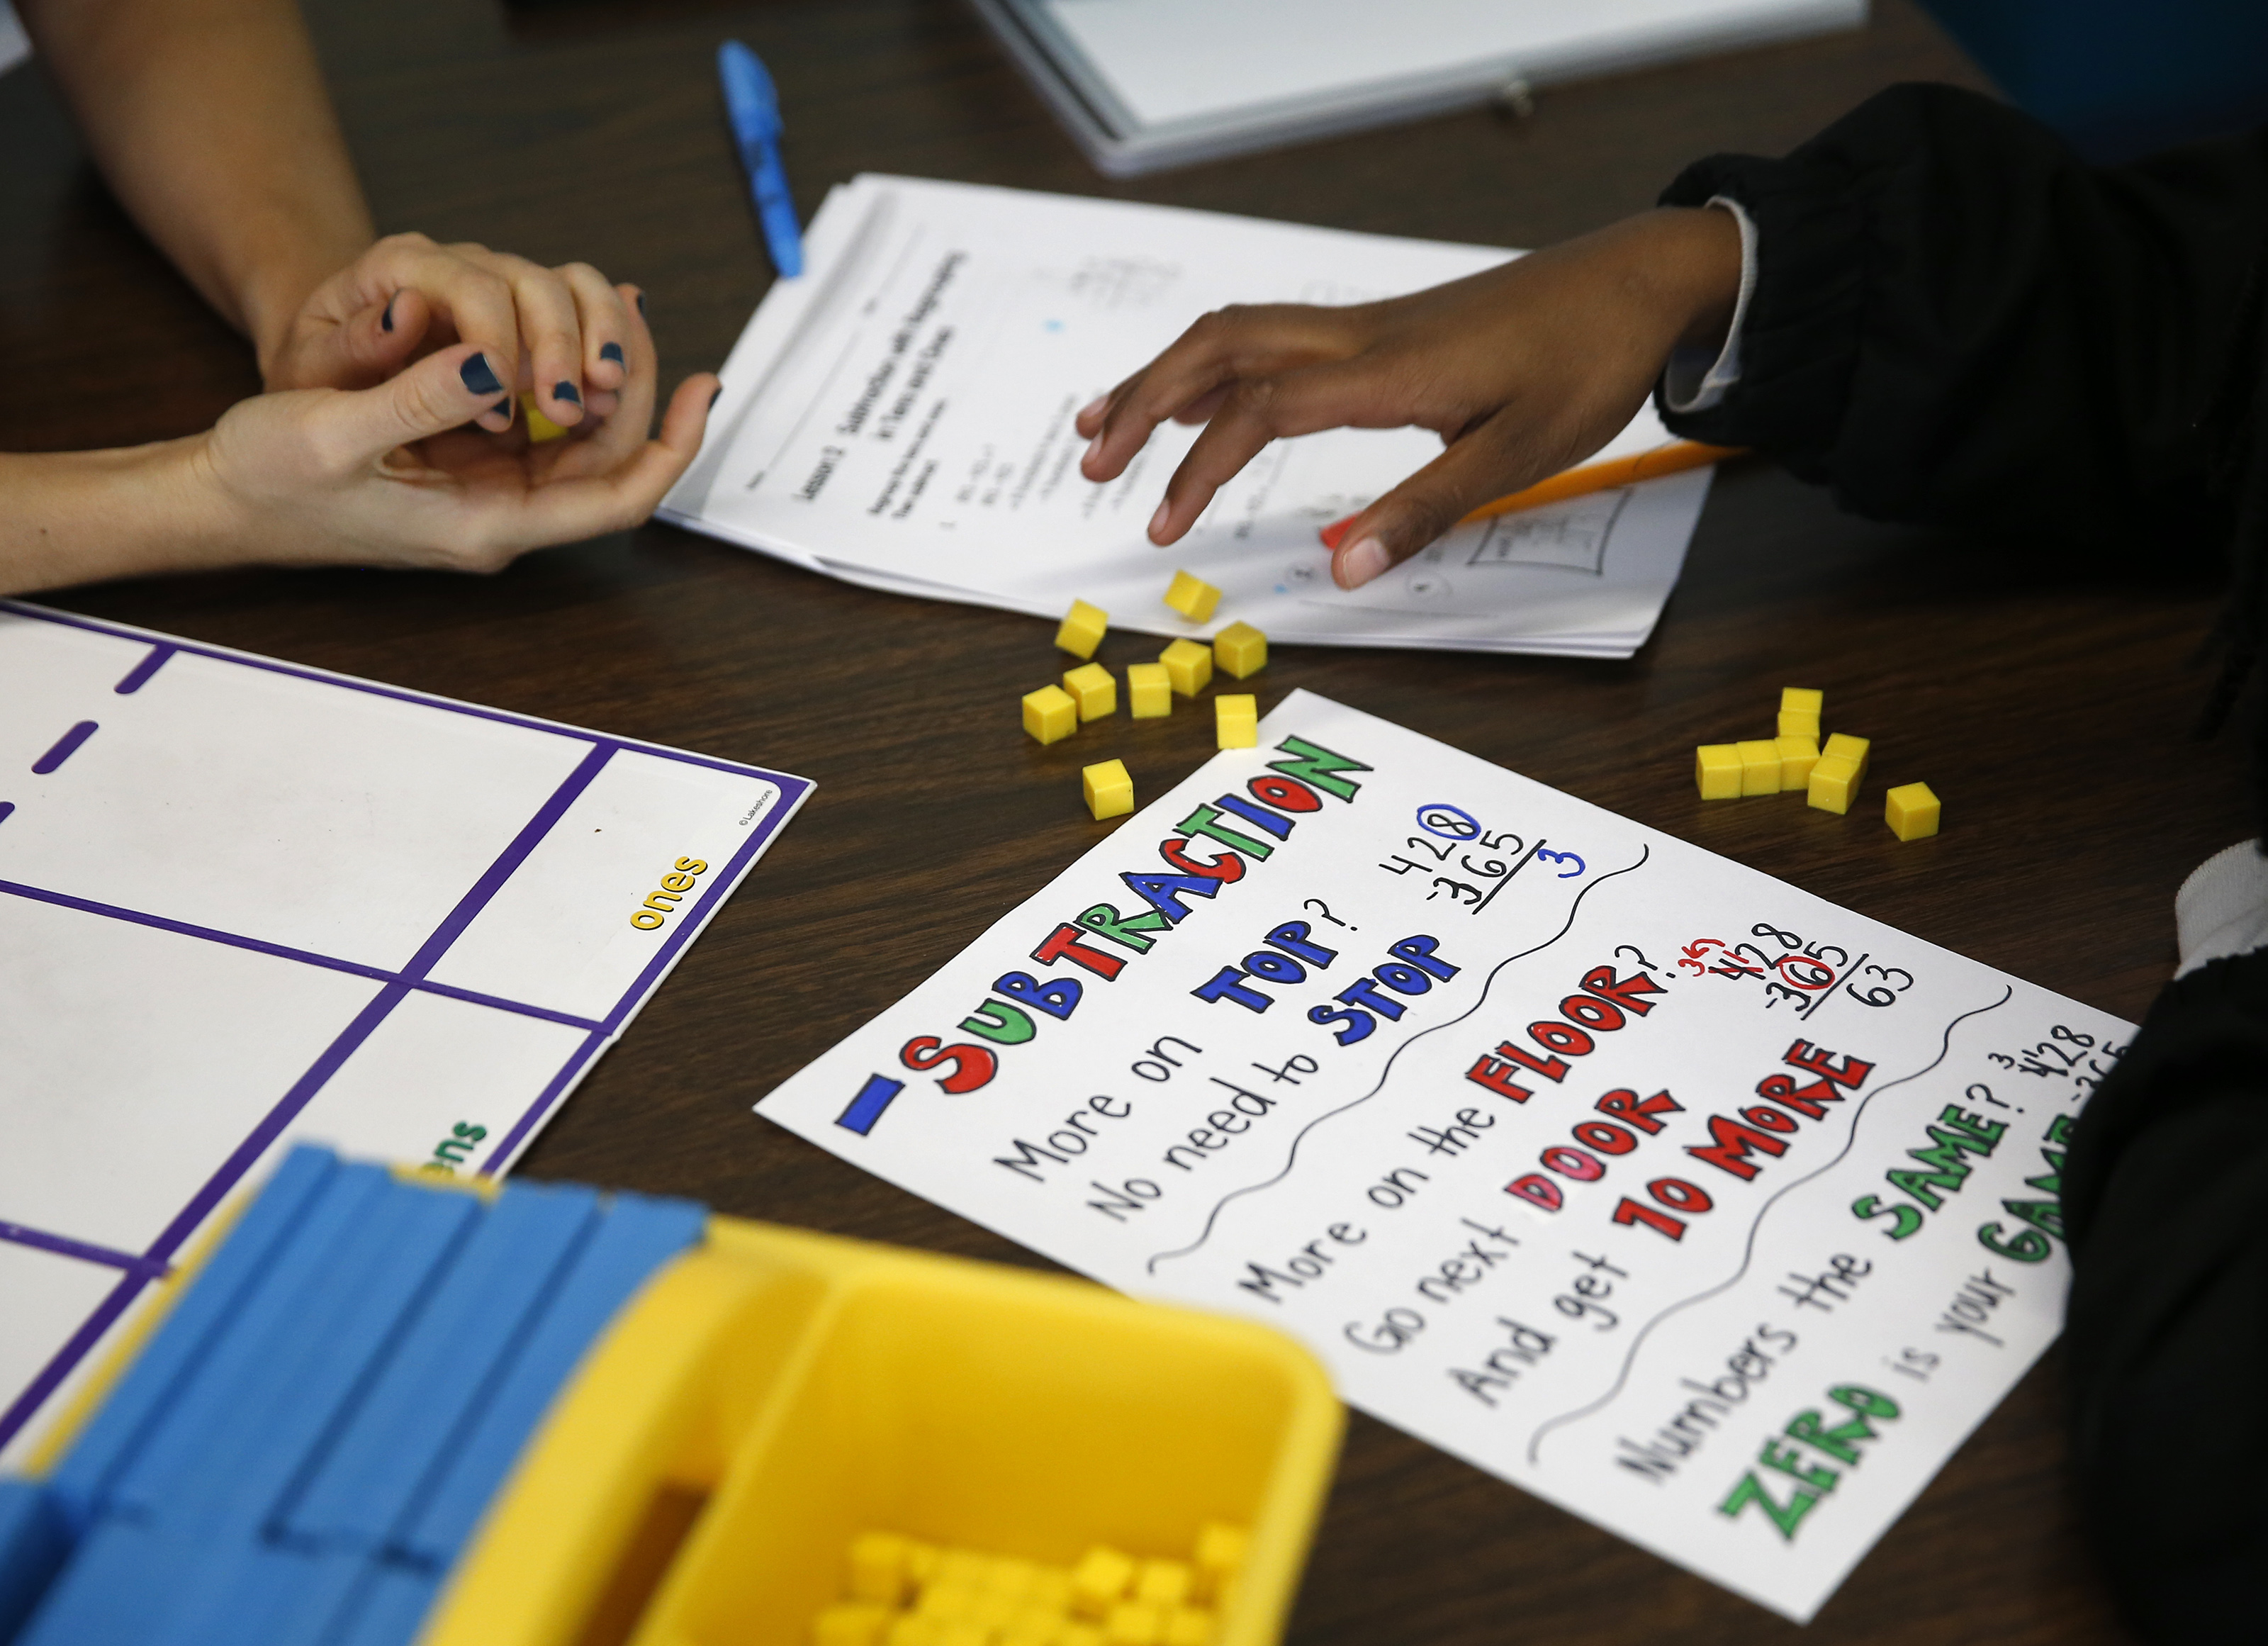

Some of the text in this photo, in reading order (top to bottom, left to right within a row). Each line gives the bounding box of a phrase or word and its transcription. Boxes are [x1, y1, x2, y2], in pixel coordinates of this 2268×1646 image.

[838, 357, 896, 435] Subtraction
[630, 856, 708, 930] ones
[899, 735, 1374, 1094] SUBTRACTION
[1379, 811, 1476, 877] 428
[1537, 848, 1586, 878] 3
[994, 897, 1357, 1182] More on TOP?
[1086, 934, 1461, 1222] No need to STOP
[1846, 964, 1914, 1007] 63
[1236, 944, 1677, 1305] More on the FLOOR?
[1343, 1088, 1686, 1356] Go next DOOR
[1446, 1316, 1557, 1409] And
[1557, 1250, 1631, 1331] get
[1611, 1176, 1714, 1244] 10
[1614, 1082, 2026, 1487] Numbers the SAME?
[1714, 1382, 1903, 1543] ZERO
[1883, 1345, 1941, 1383] is
[1936, 1267, 2019, 1349] your
